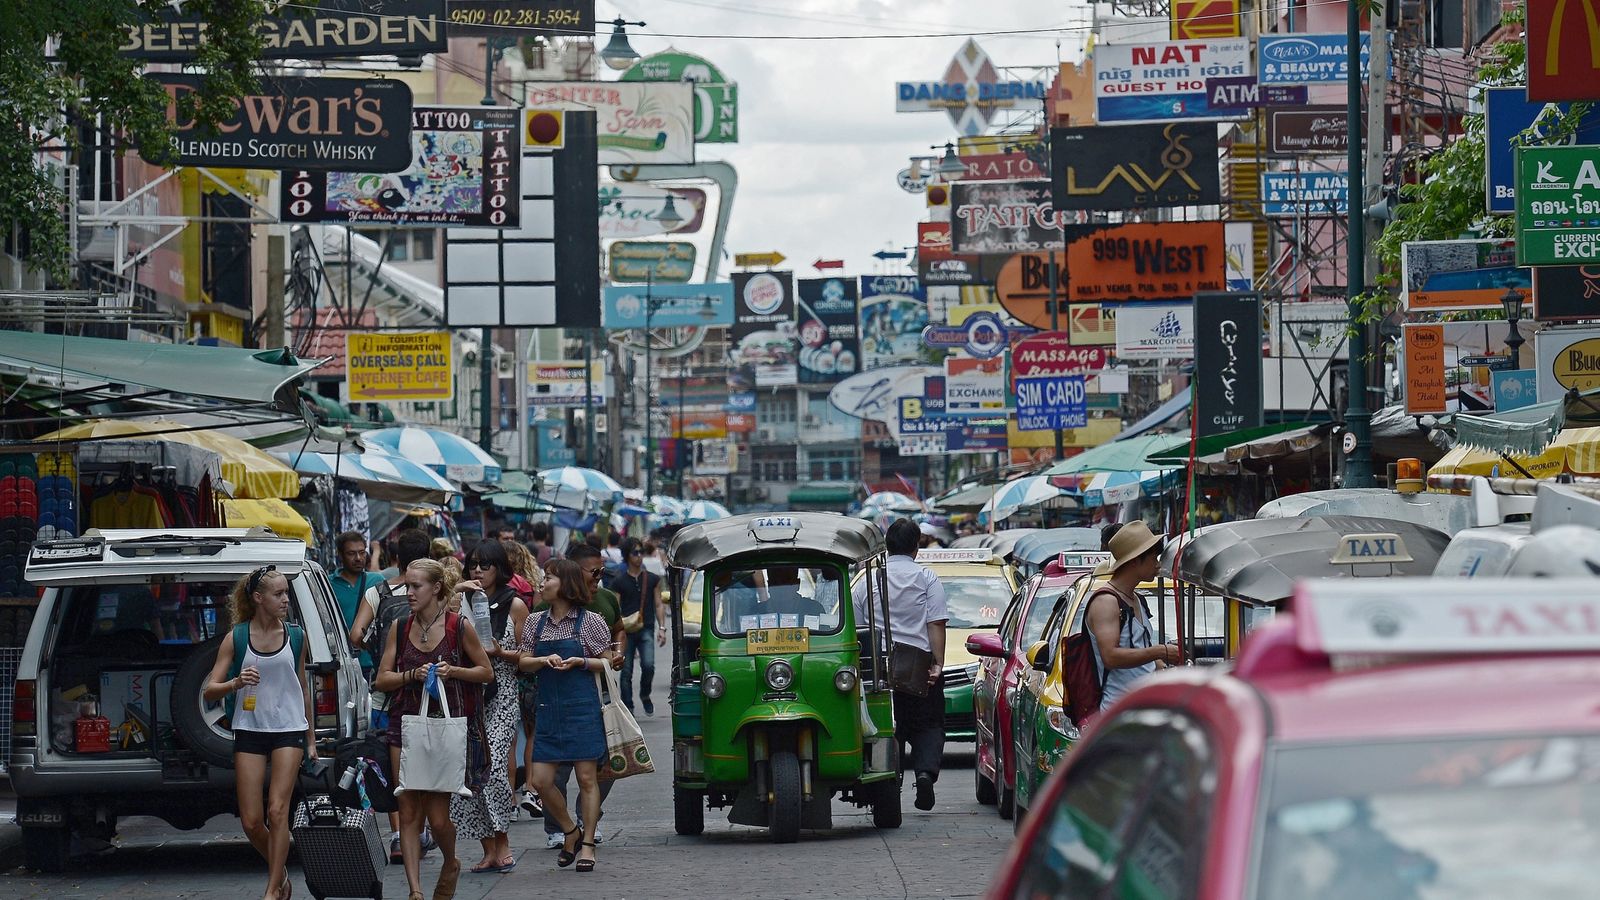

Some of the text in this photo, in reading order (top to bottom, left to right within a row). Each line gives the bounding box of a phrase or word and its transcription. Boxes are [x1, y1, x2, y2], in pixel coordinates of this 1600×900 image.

[493, 9, 580, 26] 02-281-5954
[118, 14, 437, 50] BEE GARDEN
[1132, 44, 1207, 66] NAT
[1264, 63, 1276, 74] &
[1280, 62, 1336, 73] BEAUTY
[900, 82, 966, 100] DANG
[1103, 80, 1207, 93] GUEST HO
[1213, 84, 1260, 104] ATM
[412, 111, 471, 129] ATTOO
[1312, 135, 1320, 145] &
[1322, 135, 1339, 148] Body
[489, 128, 511, 226] TATTOO
[1269, 177, 1349, 189] THAI MAS
[1287, 189, 1340, 201] BEAUTY
[348, 211, 370, 223] You
[372, 211, 398, 221] think
[1093, 237, 1129, 261] 999
[388, 335, 430, 343] TOURIST
[376, 344, 442, 352] INFORMATION
[351, 354, 447, 368] OVERSEAS CALL
[351, 371, 448, 385] INTERNET CAFE
[1018, 380, 1084, 407] SIM CARD
[1019, 415, 1049, 429] UNLOCK
[1061, 413, 1086, 426] PHONE
[1213, 415, 1244, 425] CLIFF
[757, 517, 793, 527] TAXI
[1347, 538, 1397, 557] TAXI
[1449, 601, 1600, 636] TAXI
[20, 815, 62, 823] ISUZU
